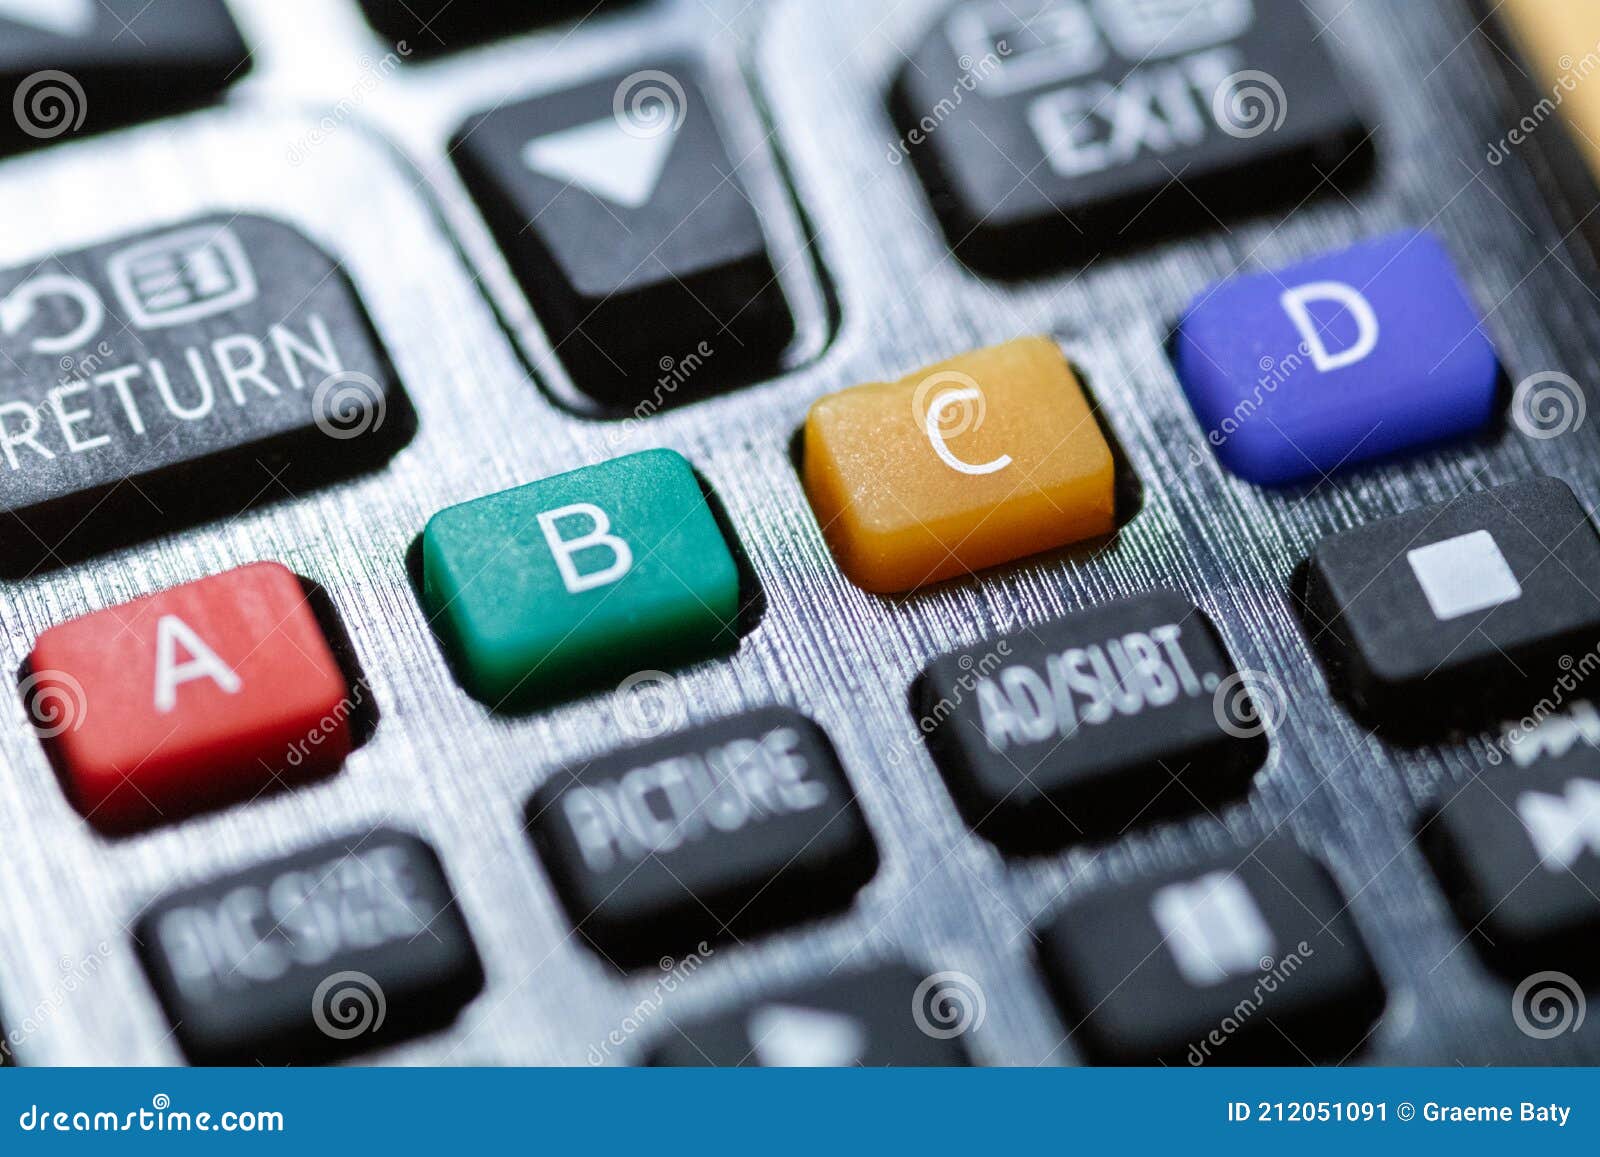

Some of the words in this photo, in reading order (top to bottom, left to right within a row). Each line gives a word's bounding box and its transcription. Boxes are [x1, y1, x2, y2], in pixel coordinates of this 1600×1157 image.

[1027, 46, 1242, 177] EXIT
[1281, 281, 1379, 372] D
[0, 314, 343, 470] RETURN
[926, 388, 1013, 475] C
[536, 502, 633, 593] B
[154, 614, 242, 713] A
[976, 624, 1221, 750] AD/SUBT.
[563, 728, 829, 873] PICTURE
